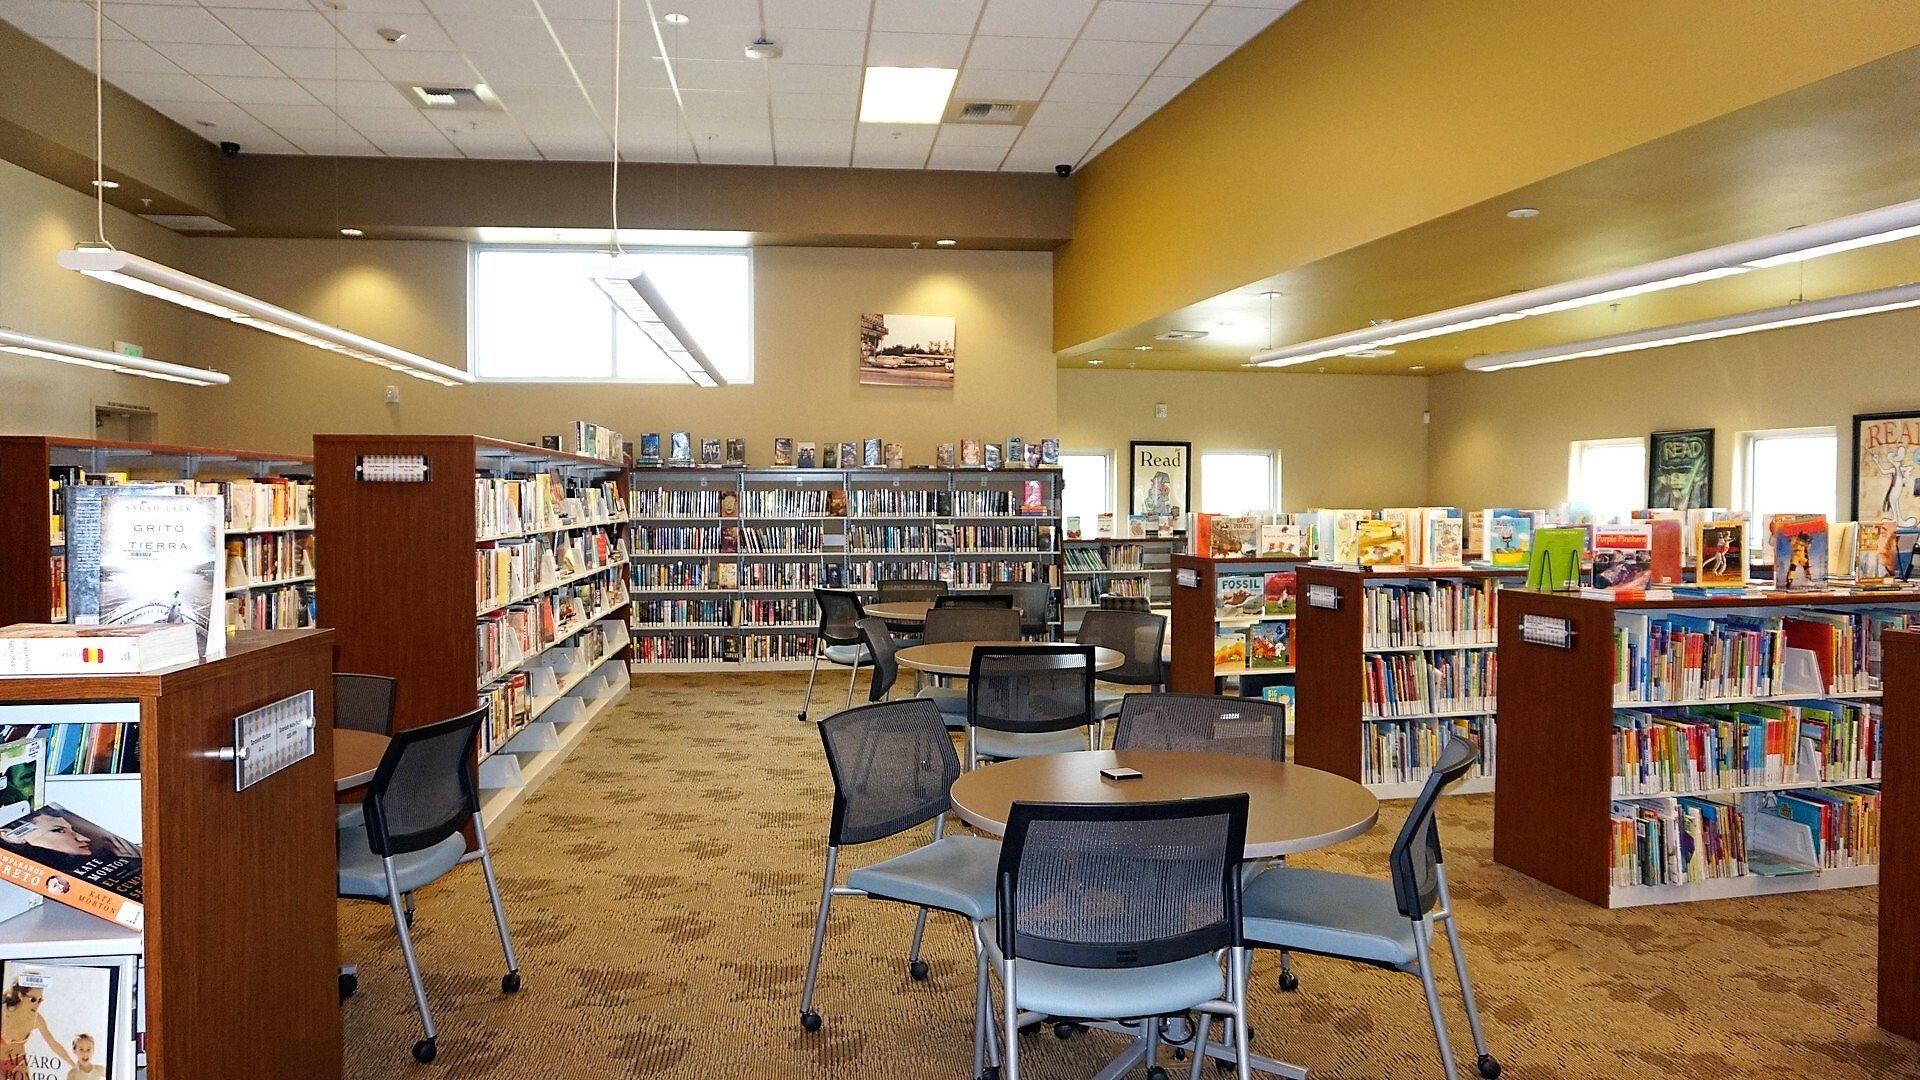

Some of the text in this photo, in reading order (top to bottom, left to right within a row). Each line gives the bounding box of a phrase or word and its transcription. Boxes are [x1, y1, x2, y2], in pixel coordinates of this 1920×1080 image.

[1868, 421, 1920, 449] REA
[1140, 450, 1181, 468] Read
[1663, 440, 1703, 460] READ
[133, 524, 184, 532] GRITO
[129, 541, 188, 550] TIERRA
[1597, 535, 1617, 545] Purple
[1222, 579, 1260, 589] FOSSIL
[0, 861, 40, 886] RETO
[73, 858, 104, 876] KATE
[87, 857, 130, 882] MORTON
[78, 895, 116, 914] MORTON
[89, 890, 112, 905] KATE
